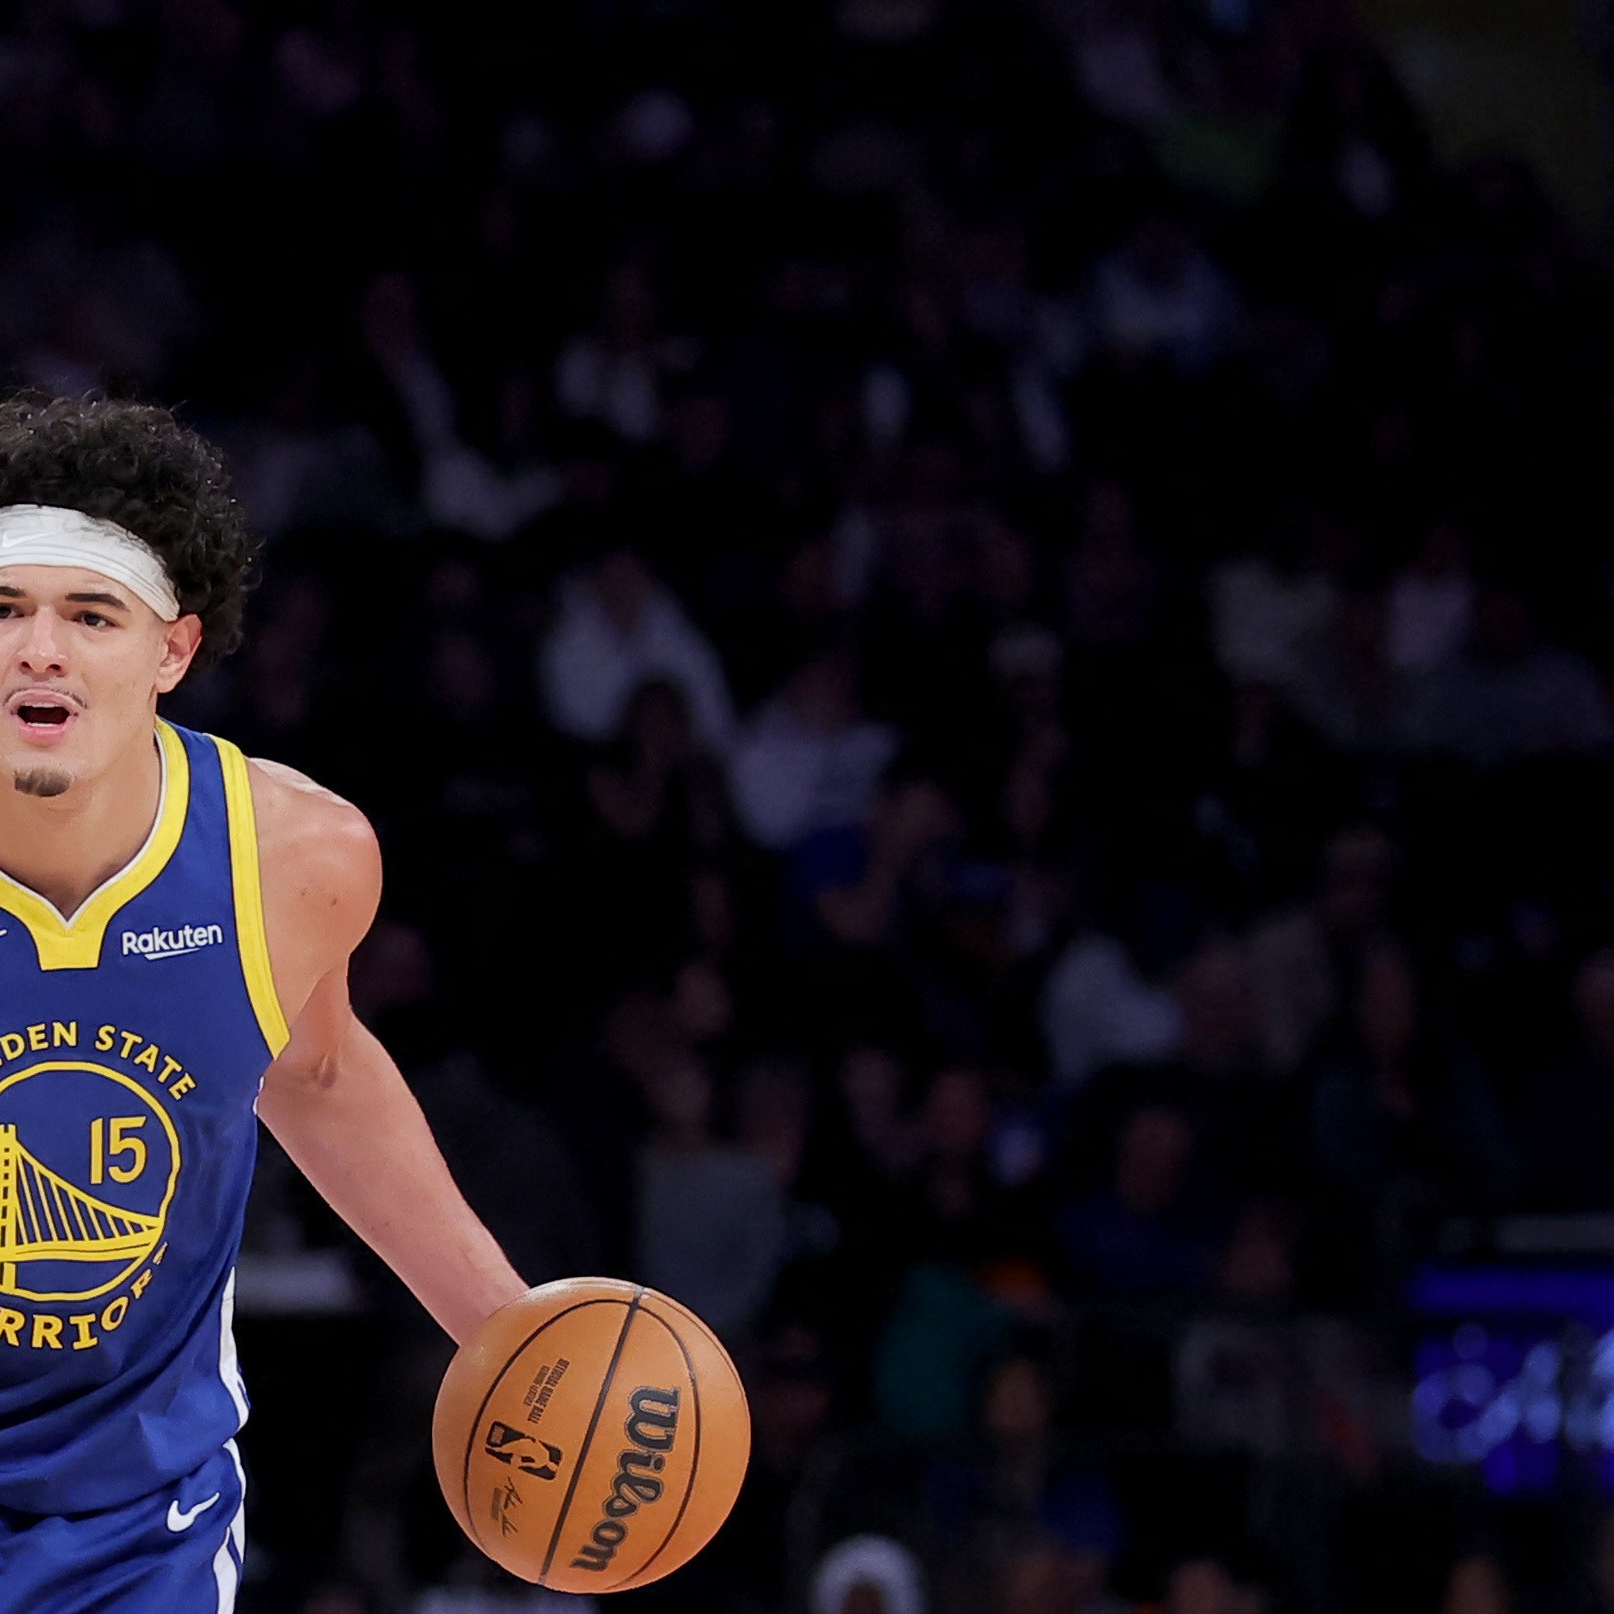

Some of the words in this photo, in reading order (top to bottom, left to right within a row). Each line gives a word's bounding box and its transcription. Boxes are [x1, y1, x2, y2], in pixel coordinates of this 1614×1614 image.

[121, 922, 224, 957] Rakuten
[94, 1024, 198, 1101] STATE
[89, 1115, 148, 1185] 15
[568, 1385, 681, 1572] Wilson
